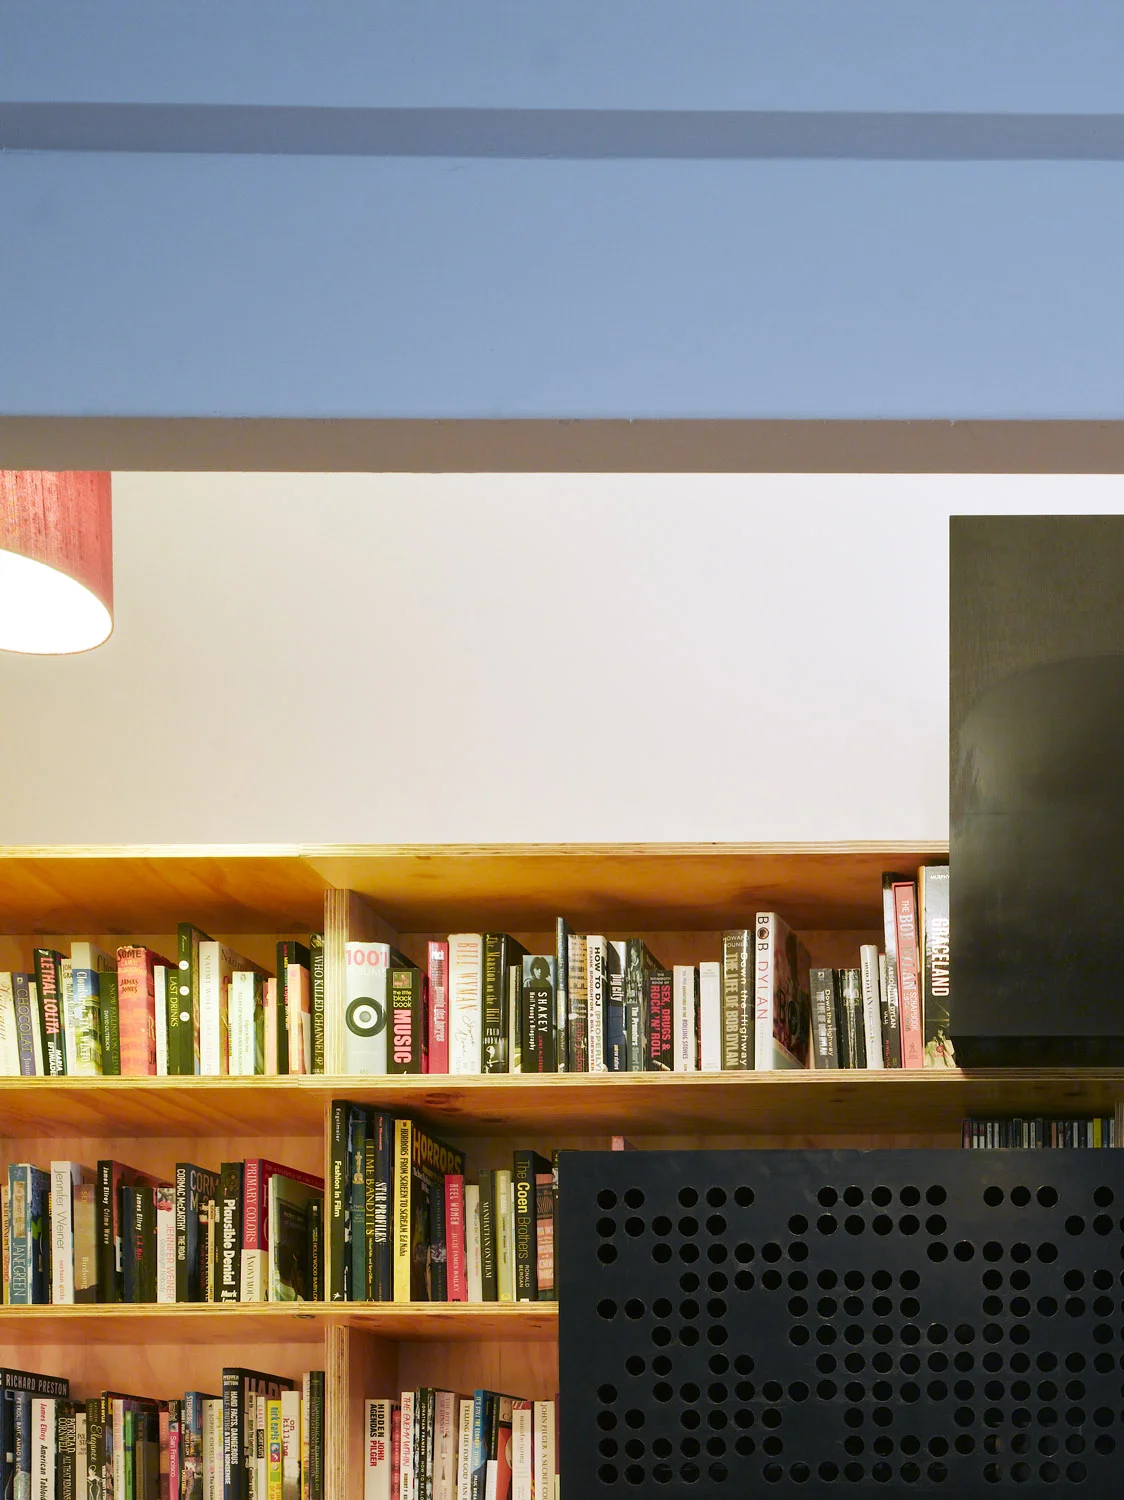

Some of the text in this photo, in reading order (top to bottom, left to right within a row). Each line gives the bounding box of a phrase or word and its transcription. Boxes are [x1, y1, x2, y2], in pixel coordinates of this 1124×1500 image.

[117, 949, 142, 962] SOME
[345, 950, 389, 967] 1001
[595, 976, 601, 988] TO
[931, 918, 950, 996] GRACELAND
[40, 957, 59, 1034] LETHAL LOLITA
[169, 977, 178, 1027] LAST DRINKS
[314, 955, 324, 1055] WHO KILLED CHANNEL
[486, 951, 500, 1023] Mansion Hill
[538, 992, 548, 1032] SHAKEY
[595, 993, 601, 1007] DJ
[757, 962, 768, 1020] DYLAN
[16, 989, 32, 1053] CHOCOLAT
[393, 1009, 412, 1064] MUSIC
[651, 986, 660, 1058] ROCK ROLL
[662, 1008, 671, 1040] DRUGS
[726, 1010, 739, 1066] BOB DYLAN
[739, 1014, 748, 1065] Highway
[177, 1168, 186, 1230] CORMAC McCARTHY
[246, 1163, 257, 1242] PRIMARY COLORS
[400, 1128, 409, 1232] HORRORS FROM SCREEN SCREAM
[54, 1169, 68, 1250] Jennifer Weiner
[517, 1160, 531, 1259] The Coen Brothers
[222, 1200, 236, 1285] Plausible Denial
[13, 1265, 26, 1296] GREEN
[5, 1373, 68, 1396] RICHARD PRESTON
[86, 1424, 103, 1463] Elegance
[377, 1404, 385, 1460] HIDDEN JOHN
[39, 1445, 48, 1500] American Tabloid
